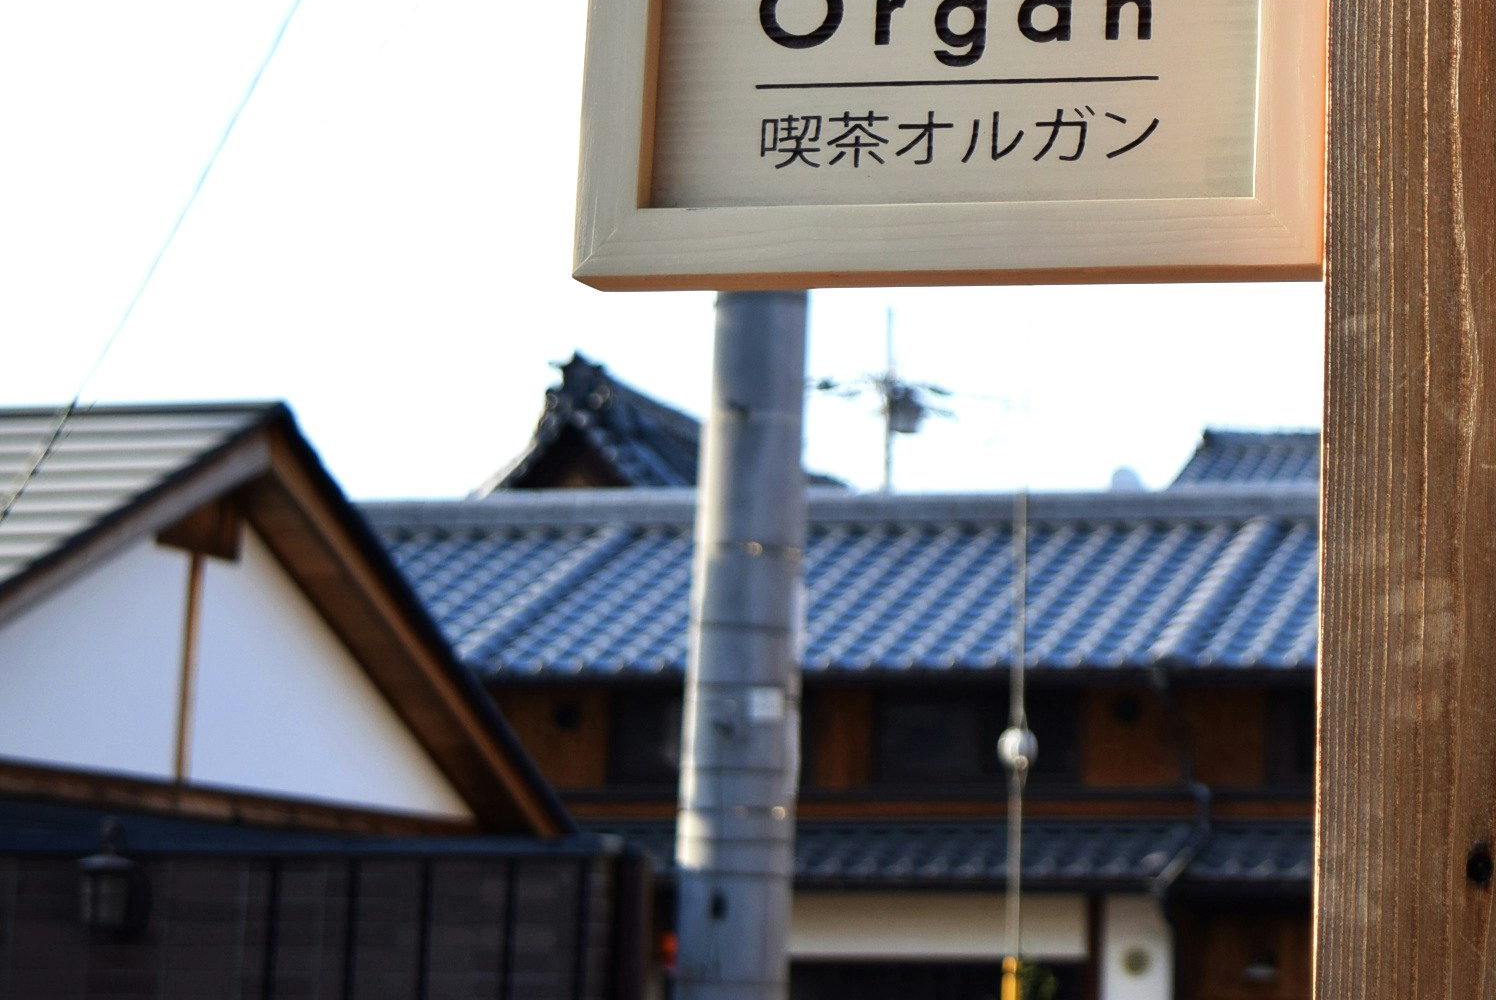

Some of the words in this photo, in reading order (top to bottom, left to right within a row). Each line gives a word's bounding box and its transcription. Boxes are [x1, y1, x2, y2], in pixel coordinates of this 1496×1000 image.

[760, 105, 1160, 169] 喫茶オルガン
